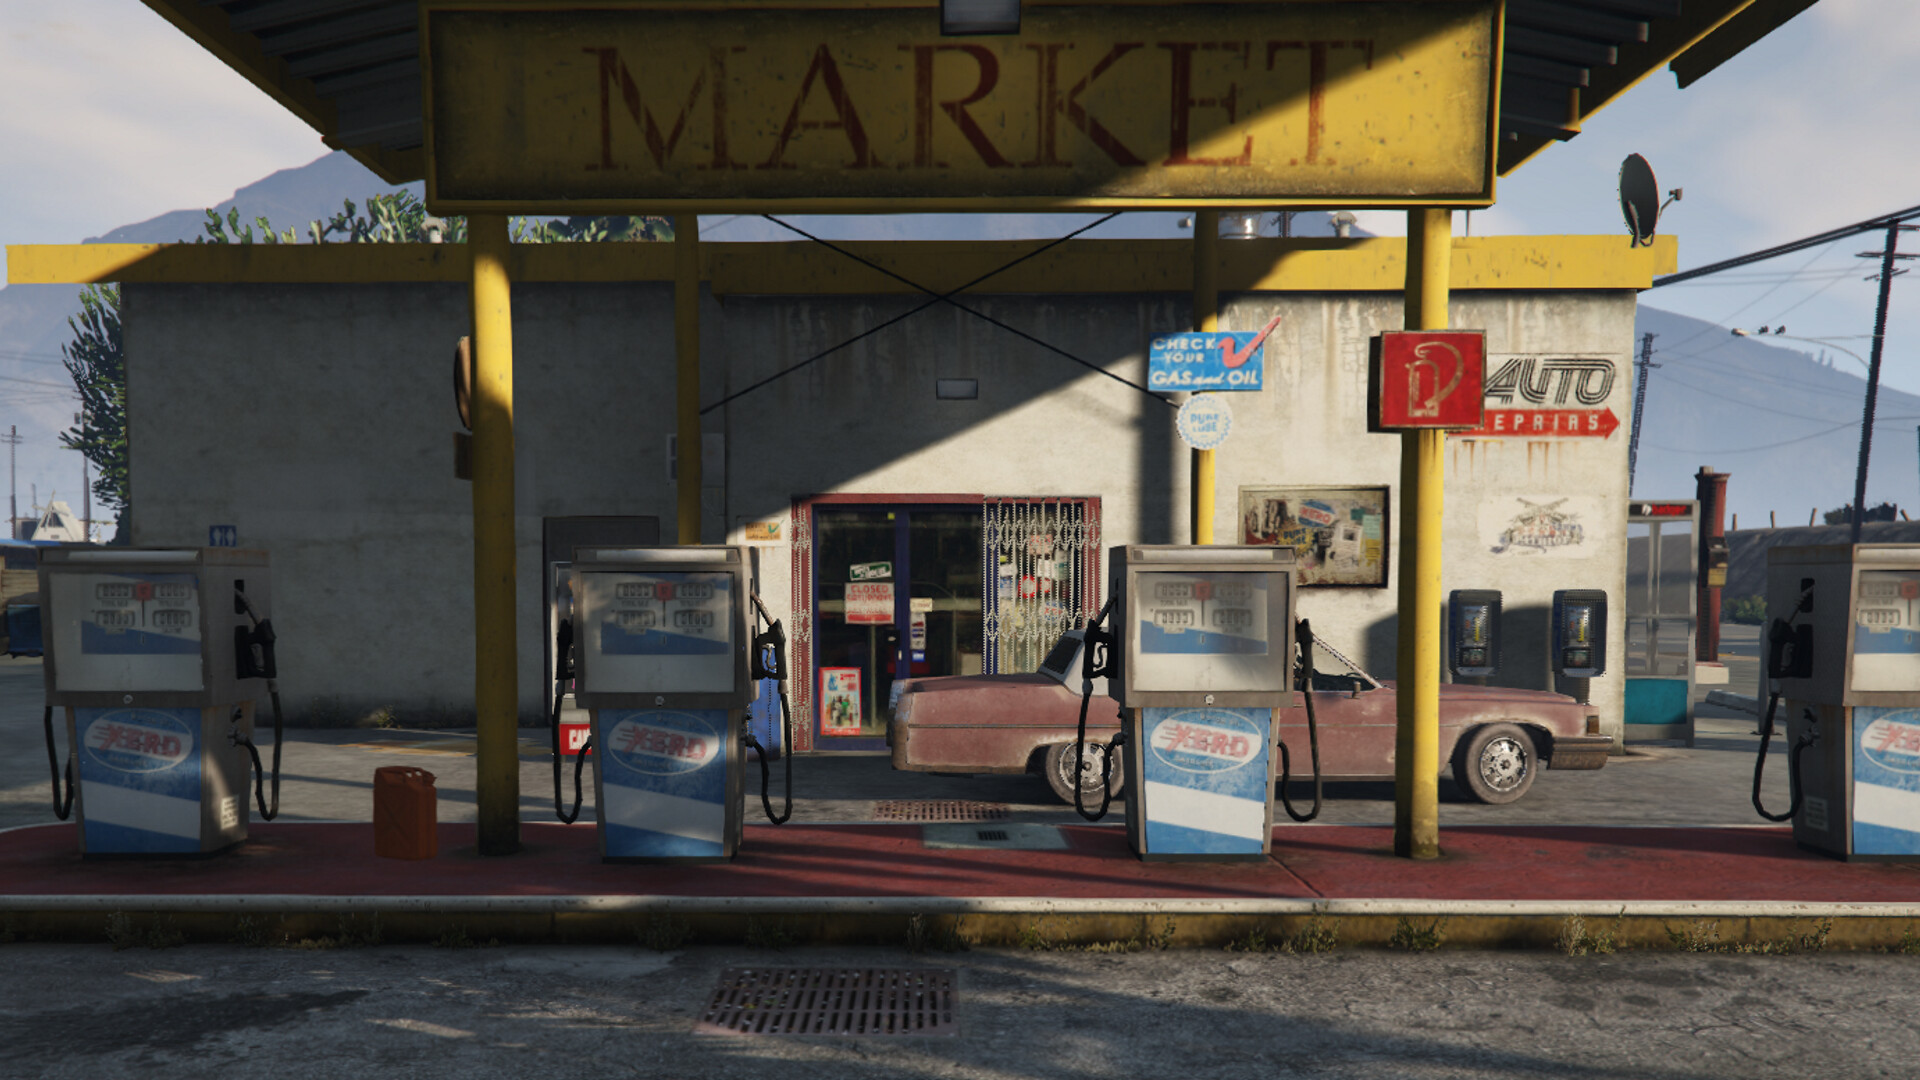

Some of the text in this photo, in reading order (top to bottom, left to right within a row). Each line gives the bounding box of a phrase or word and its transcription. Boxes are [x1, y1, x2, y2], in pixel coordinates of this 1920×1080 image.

[581, 40, 1374, 170] MARKET
[1151, 337, 1217, 350] CHECK
[1163, 352, 1205, 364] YOUR
[1151, 370, 1193, 385] GAS
[1227, 370, 1259, 385] OIL
[1485, 358, 1615, 405] AUTO
[1475, 413, 1599, 431] EPAIRS
[850, 584, 889, 594] CLOSED
